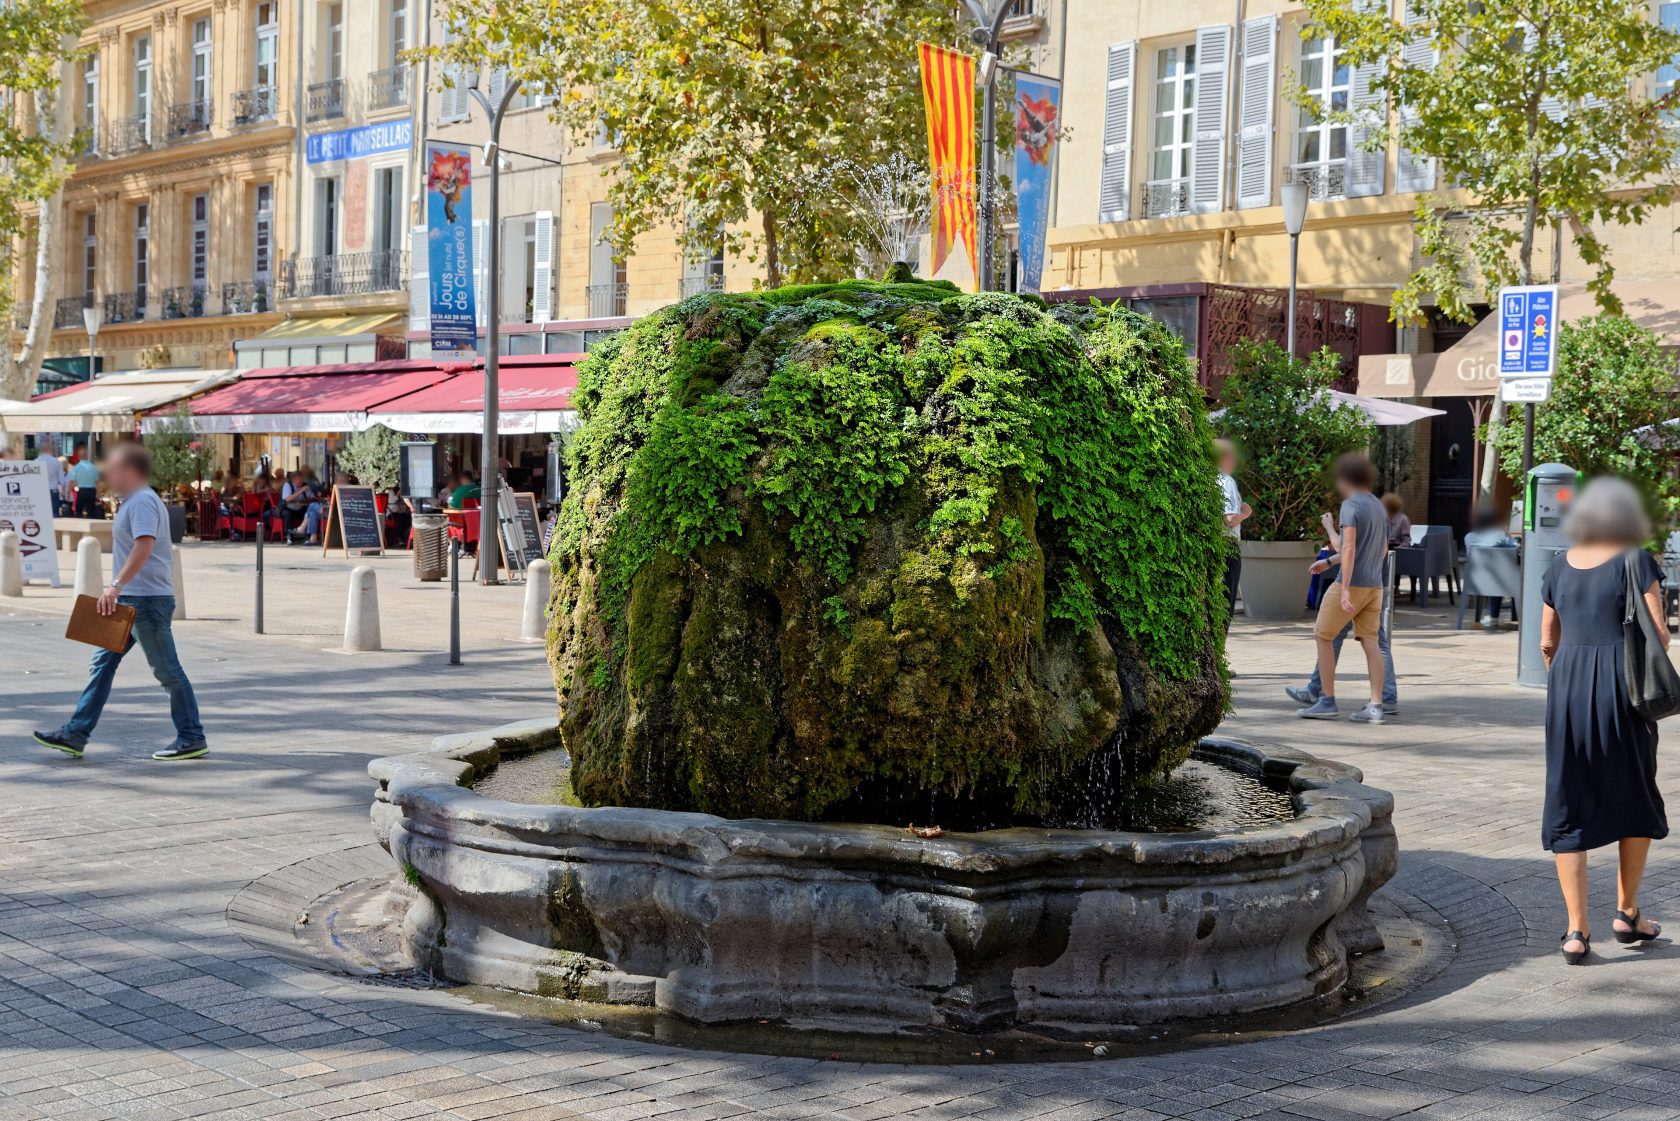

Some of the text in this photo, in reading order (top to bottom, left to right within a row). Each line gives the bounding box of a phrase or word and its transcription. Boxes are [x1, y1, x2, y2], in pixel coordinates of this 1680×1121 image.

[308, 122, 410, 160] LE PETIT MARSEILLAIS
[454, 226, 468, 310] de Cirque(s)
[439, 273, 453, 309] Jours
[1457, 357, 1498, 381] Gio
[9, 483, 19, 494] P
